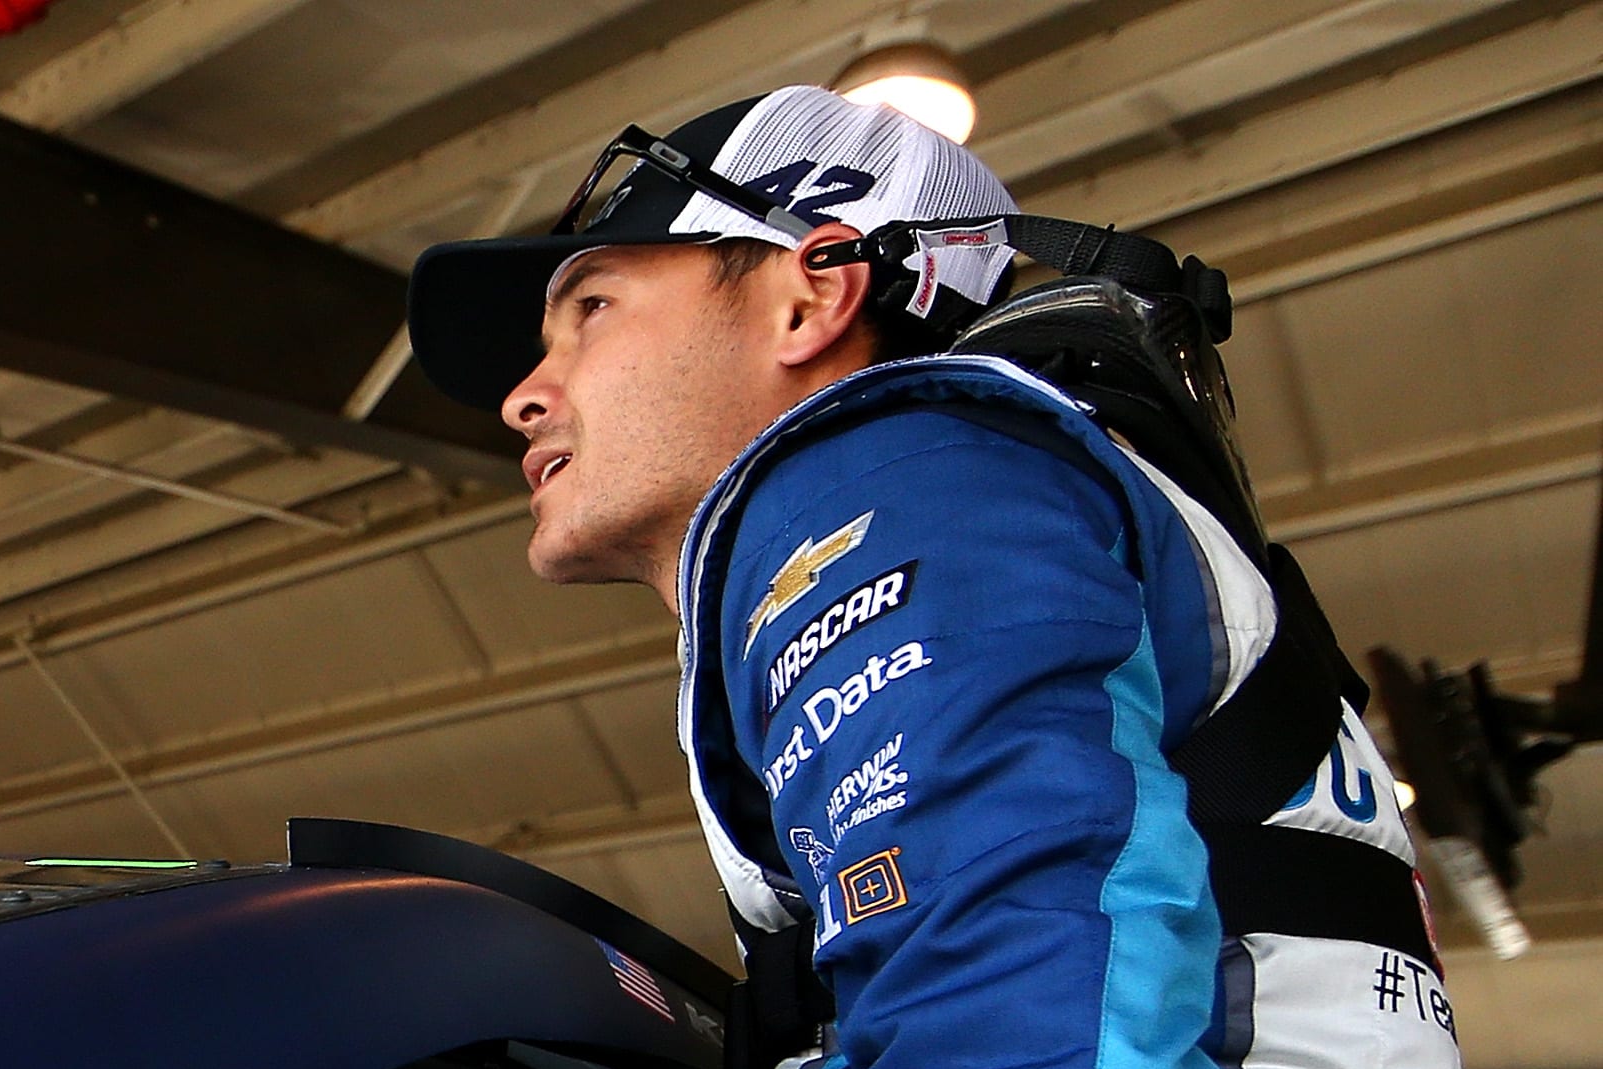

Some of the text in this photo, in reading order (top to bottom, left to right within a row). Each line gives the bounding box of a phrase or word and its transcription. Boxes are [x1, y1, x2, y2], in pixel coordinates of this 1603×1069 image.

[740, 157, 876, 228] 42
[916, 253, 935, 309] SIMPSON
[768, 571, 905, 713] NASCAR
[762, 725, 814, 800] irst
[826, 733, 904, 821] HERWIN
[1373, 951, 1458, 1047] #Te
